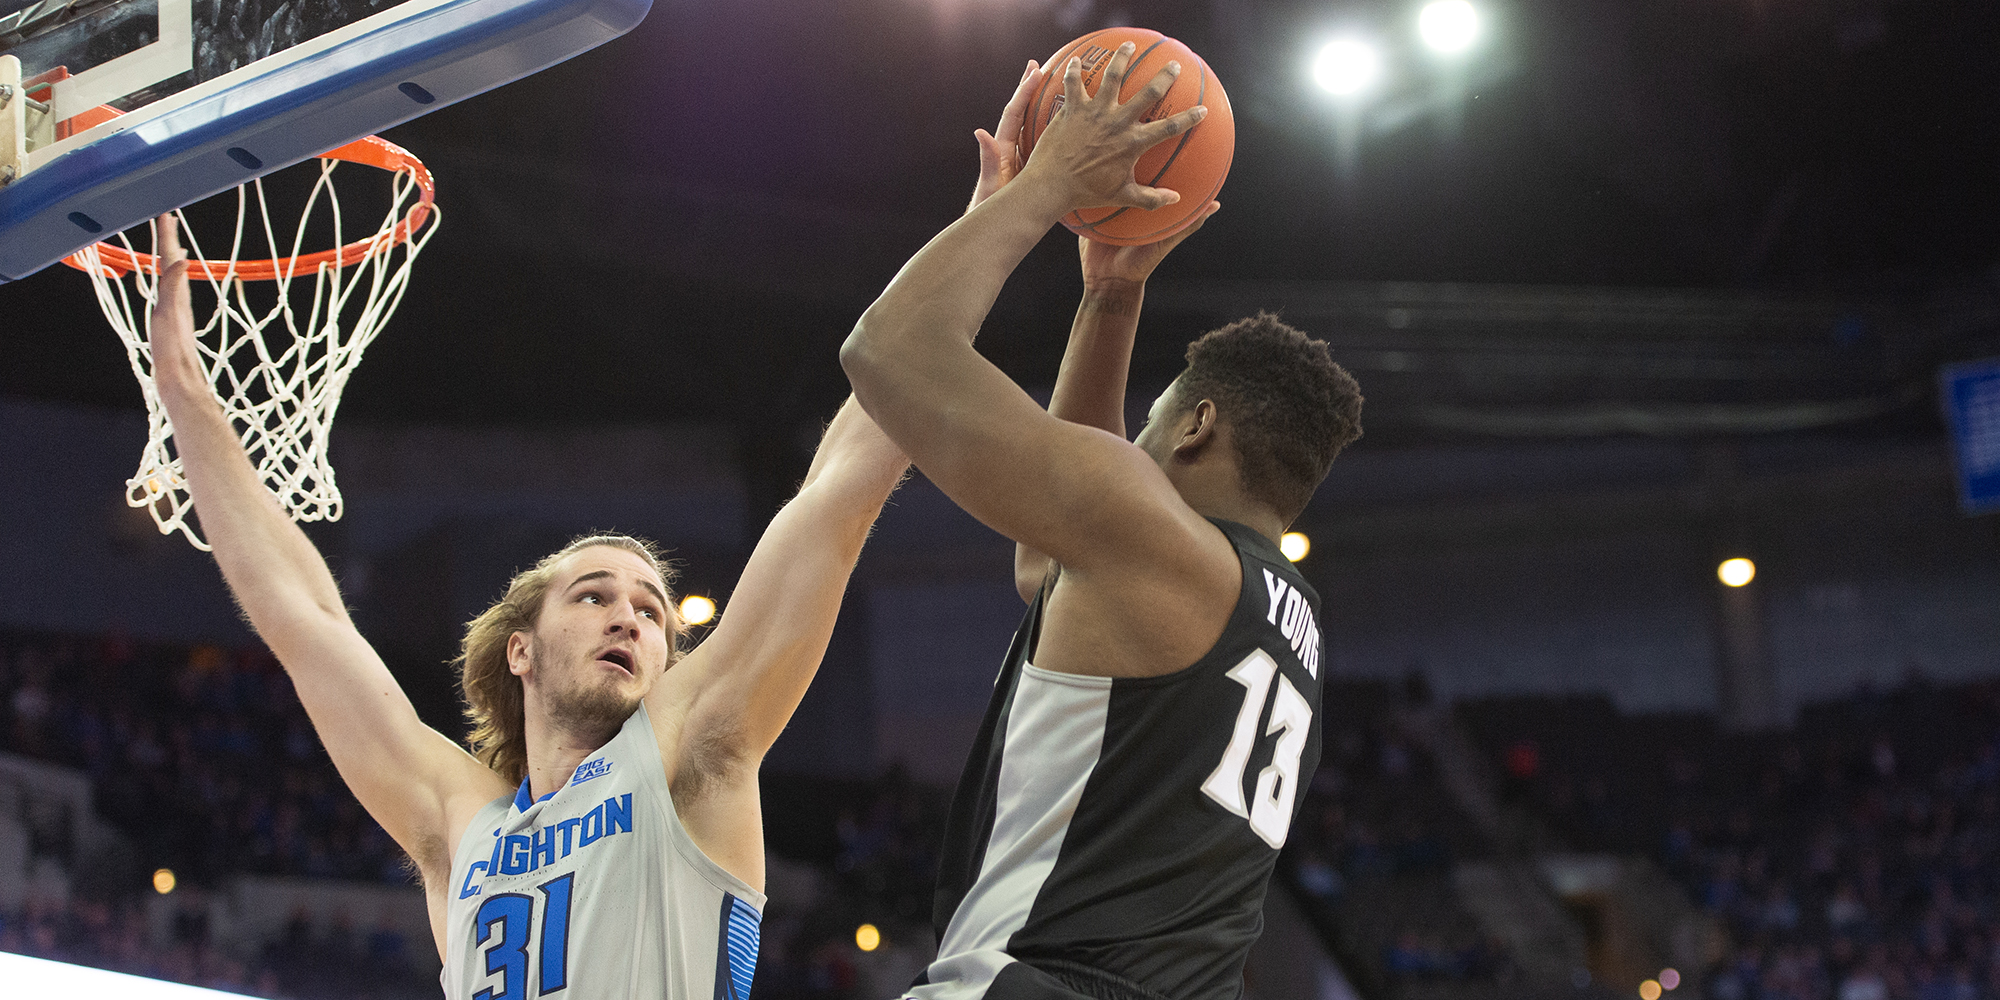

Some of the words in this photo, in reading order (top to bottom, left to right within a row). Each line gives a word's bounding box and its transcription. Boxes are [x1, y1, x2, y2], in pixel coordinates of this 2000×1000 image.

[1262, 567, 1320, 681] YOUNG
[572, 761, 614, 782] EAST
[575, 757, 605, 774] BIG
[1200, 646, 1313, 850] 13
[459, 792, 633, 899] CIGHTON
[472, 871, 575, 1000] 31
